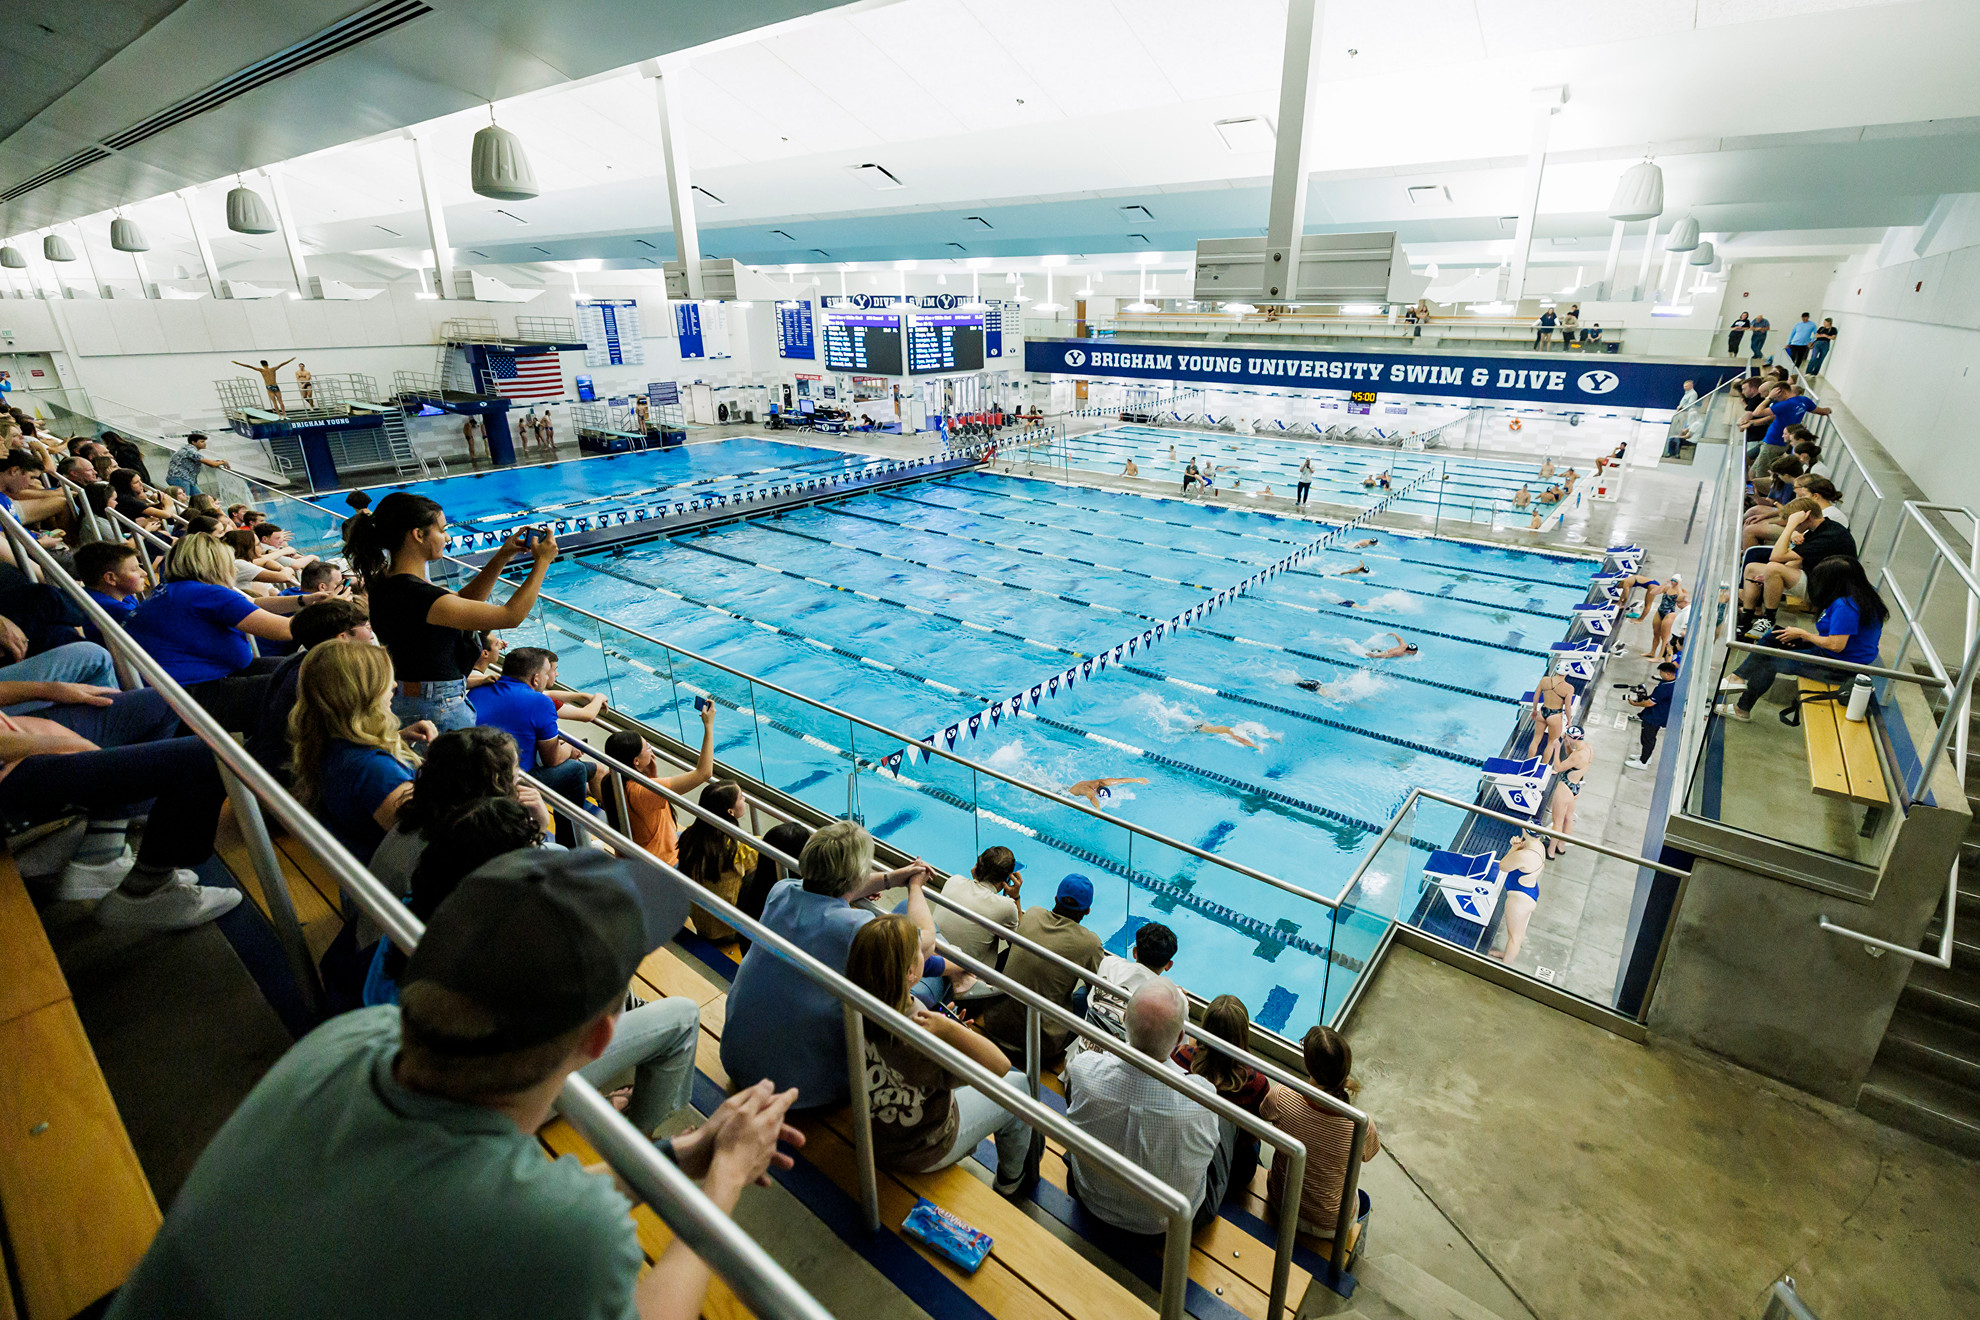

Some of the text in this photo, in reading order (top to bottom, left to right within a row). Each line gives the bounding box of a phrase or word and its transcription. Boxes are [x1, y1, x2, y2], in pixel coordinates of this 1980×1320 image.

[1090, 352, 1172, 370] BRIGHAM
[1178, 355, 1242, 373] YOUNG
[1248, 358, 1384, 380] UNIVERSITY
[1390, 364, 1464, 386] SWIM
[1471, 368, 1489, 386] &
[1496, 369, 1566, 390] DIVE
[1352, 392, 1376, 402] 45:00
[291, 420, 325, 429] BRIGHAM
[1514, 794, 1522, 803] 6
[1464, 898, 1472, 909] 7
